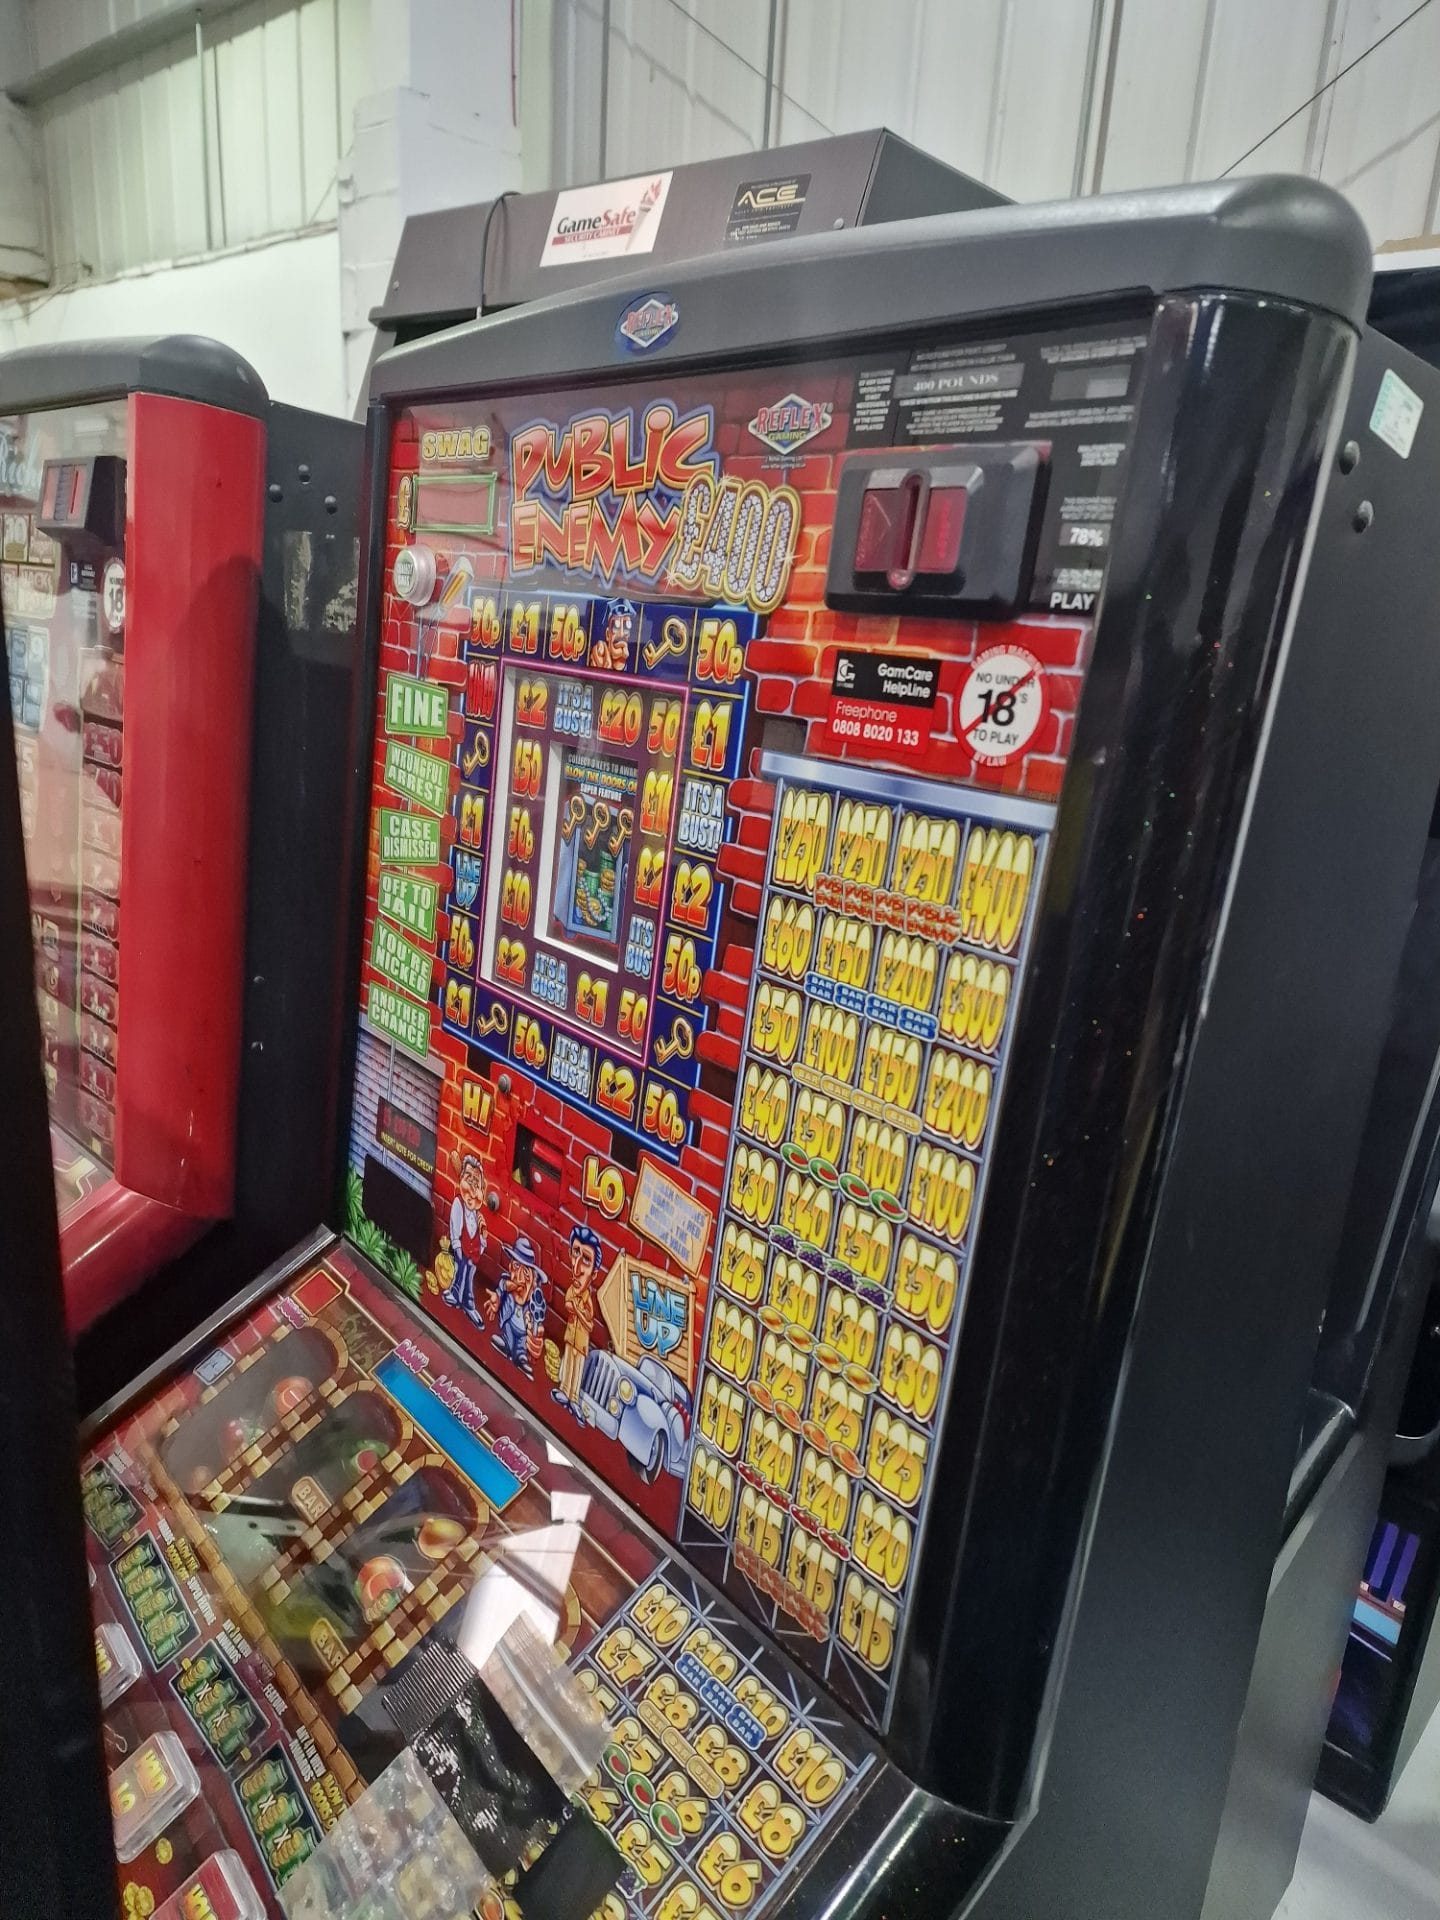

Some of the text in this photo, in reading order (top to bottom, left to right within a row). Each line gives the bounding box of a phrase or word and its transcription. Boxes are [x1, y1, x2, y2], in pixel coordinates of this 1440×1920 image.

[557, 207, 636, 235] GameSafe
[738, 184, 805, 208] ACE
[422, 427, 491, 461] SWAG
[757, 403, 827, 434] REFLEX
[768, 431, 807, 441] GAMING
[513, 403, 717, 503] PUBLIC
[398, 476, 411, 528] £
[513, 473, 800, 613] ENEMY £400
[1070, 526, 1105, 547] 78%
[471, 596, 501, 648] 50p
[510, 601, 541, 653] £1
[1050, 592, 1096, 611] PLAY
[549, 603, 586, 661] 50p
[696, 618, 744, 684] 50p
[878, 662, 934, 683] GamCare
[883, 680, 931, 699] HelpLine
[976, 672, 1035, 689] NO UNDR
[391, 683, 444, 727] FINE
[516, 677, 548, 729] £2
[554, 709, 593, 738] BUST!
[597, 689, 642, 747] £20
[836, 701, 897, 722] Freephone
[978, 689, 1016, 727] 18
[691, 700, 732, 771] £1
[832, 719, 920, 747] 0808 8020 133
[974, 728, 1019, 746] TO PLAY
[388, 766, 443, 808] ARREST
[391, 746, 443, 788] WRONGFUL
[460, 795, 484, 849] £1
[684, 779, 725, 818] IT'S A
[383, 836, 436, 858] DISMISSED
[389, 815, 431, 841] CASE
[508, 807, 534, 863] 50p
[678, 812, 722, 852] BUST!
[773, 787, 831, 895] £250
[831, 799, 892, 887] £250
[891, 812, 960, 905] £250
[382, 876, 431, 911] OFF TO
[382, 892, 428, 933] JAIL
[502, 868, 531, 930] £10
[671, 859, 713, 930] £2
[959, 826, 1034, 954] £400
[379, 924, 429, 980] YOU'RE
[449, 913, 474, 971] 50p
[496, 936, 527, 987] £2
[624, 943, 652, 980] BUS
[762, 895, 815, 981] £60
[816, 912, 874, 988] £150
[375, 945, 426, 994] NICKED
[531, 972, 568, 1010] BUST!
[662, 934, 702, 1003] 50p
[810, 986, 831, 999] BAR
[811, 977, 832, 990] BAR
[842, 987, 864, 1001] BAR
[875, 931, 939, 1012] £200
[372, 988, 426, 1033] ANOTHER
[372, 1004, 424, 1050] CHANCE
[445, 978, 471, 1029] £1
[576, 971, 608, 1028] £1
[752, 981, 801, 1065] £50
[840, 997, 862, 1010] BAR
[871, 1008, 894, 1023] BAR
[873, 999, 896, 1013] BAR
[906, 1011, 930, 1027] BAR
[940, 952, 1011, 1054] £300
[513, 1013, 547, 1070] 50p
[555, 1033, 580, 1066] IT'S
[803, 1000, 859, 1083] £100
[904, 1020, 929, 1037] BAR
[551, 1055, 591, 1098] BUST!
[596, 1059, 636, 1121] £2
[861, 1023, 922, 1111] £150
[462, 1079, 491, 1136] HI
[643, 1081, 686, 1147] 50p
[740, 1065, 790, 1148] £40
[790, 1086, 846, 1166] £50
[923, 1048, 993, 1150] £200
[848, 1112, 908, 1200] £100
[582, 1154, 626, 1221] LO
[729, 1143, 778, 1228] £30
[779, 1170, 833, 1251] £40
[907, 1141, 975, 1245] £100
[719, 1221, 768, 1305] £25
[834, 1202, 893, 1285] £50
[629, 1272, 690, 1326] LINE
[768, 1252, 820, 1333] £30
[894, 1233, 958, 1335] £50
[633, 1308, 683, 1358] UP
[709, 1297, 756, 1383] £20
[821, 1286, 879, 1370] £30
[758, 1331, 809, 1412] £25
[880, 1322, 942, 1423] £30
[700, 1372, 746, 1457] £15
[810, 1366, 867, 1453] £25
[491, 1436, 540, 1483] CREDIT
[746, 1408, 796, 1493] £20
[867, 1406, 930, 1508] £25
[299, 1483, 326, 1519] BAR
[689, 1445, 734, 1532] £10
[798, 1447, 851, 1536] £20
[736, 1485, 785, 1570] £15
[852, 1490, 912, 1593] £20
[786, 1526, 840, 1617] £15
[630, 1584, 692, 1647] £10
[840, 1571, 897, 1672] £15
[316, 1629, 343, 1668] BAR
[681, 1627, 738, 1685] £10
[681, 1666, 701, 1687] BAR
[687, 1658, 707, 1679] BAR
[644, 1673, 699, 1733] £8
[707, 1692, 727, 1714] BAR
[713, 1684, 733, 1706] BAR
[734, 1675, 791, 1740] £10
[738, 1711, 760, 1735] BAR
[694, 1724, 750, 1790] £8
[732, 1718, 752, 1742] BAR
[772, 1727, 846, 1808] £10
[655, 1771, 709, 1837] £6
[737, 1779, 806, 1858] £8
[618, 1819, 674, 1888] £5
[696, 1831, 762, 1911] £6
